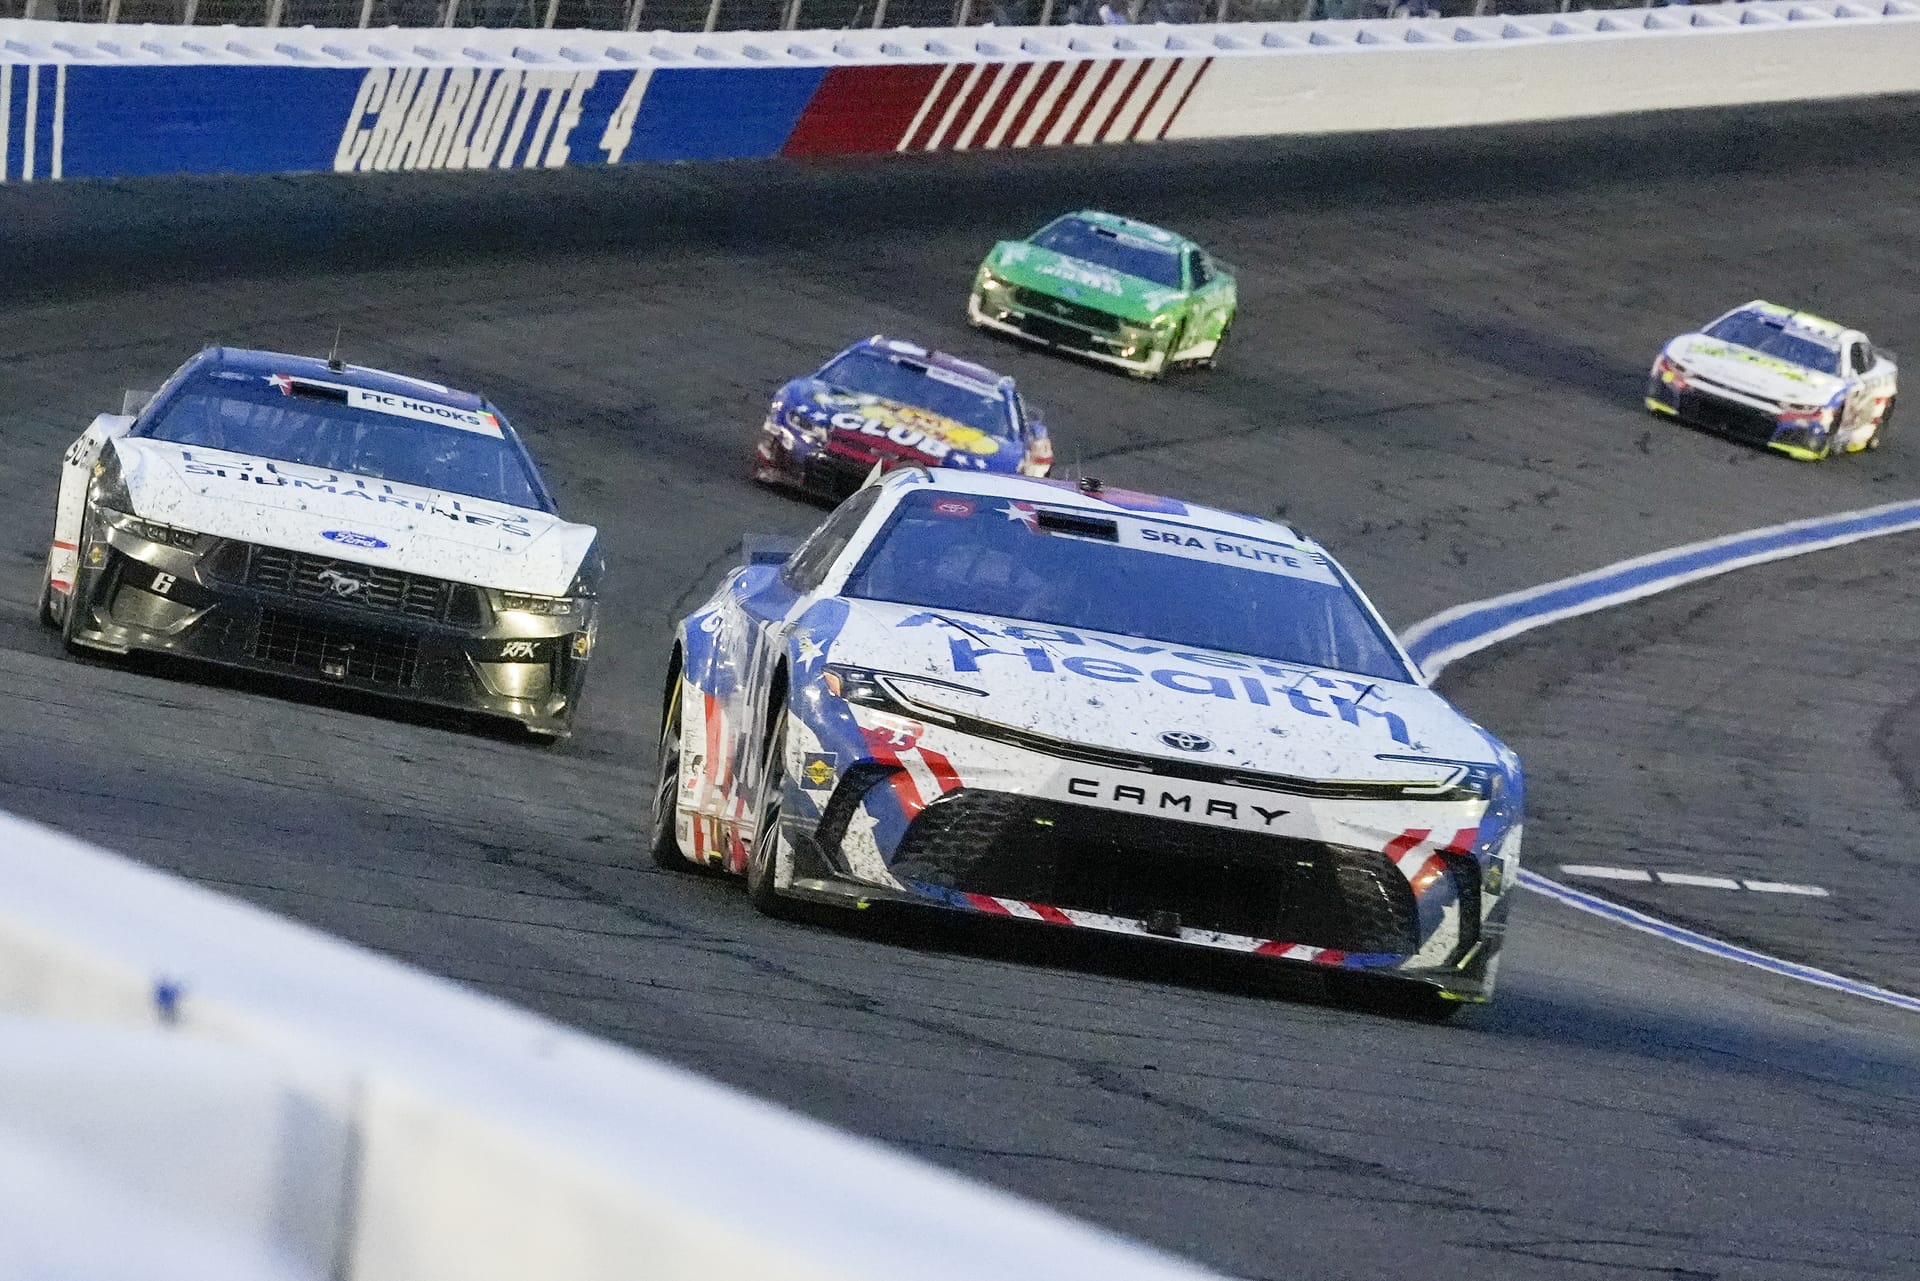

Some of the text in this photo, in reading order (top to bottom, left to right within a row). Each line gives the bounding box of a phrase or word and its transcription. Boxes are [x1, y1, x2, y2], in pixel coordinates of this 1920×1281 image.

[334, 67, 656, 172] CHARLOTTE 4
[403, 402, 481, 426] HOOKS
[830, 413, 951, 458] CLUB
[1141, 528, 1301, 569] SRA PLITE
[152, 571, 176, 594] 6
[948, 635, 1411, 747] Health
[1068, 777, 1290, 826] CAMRY
